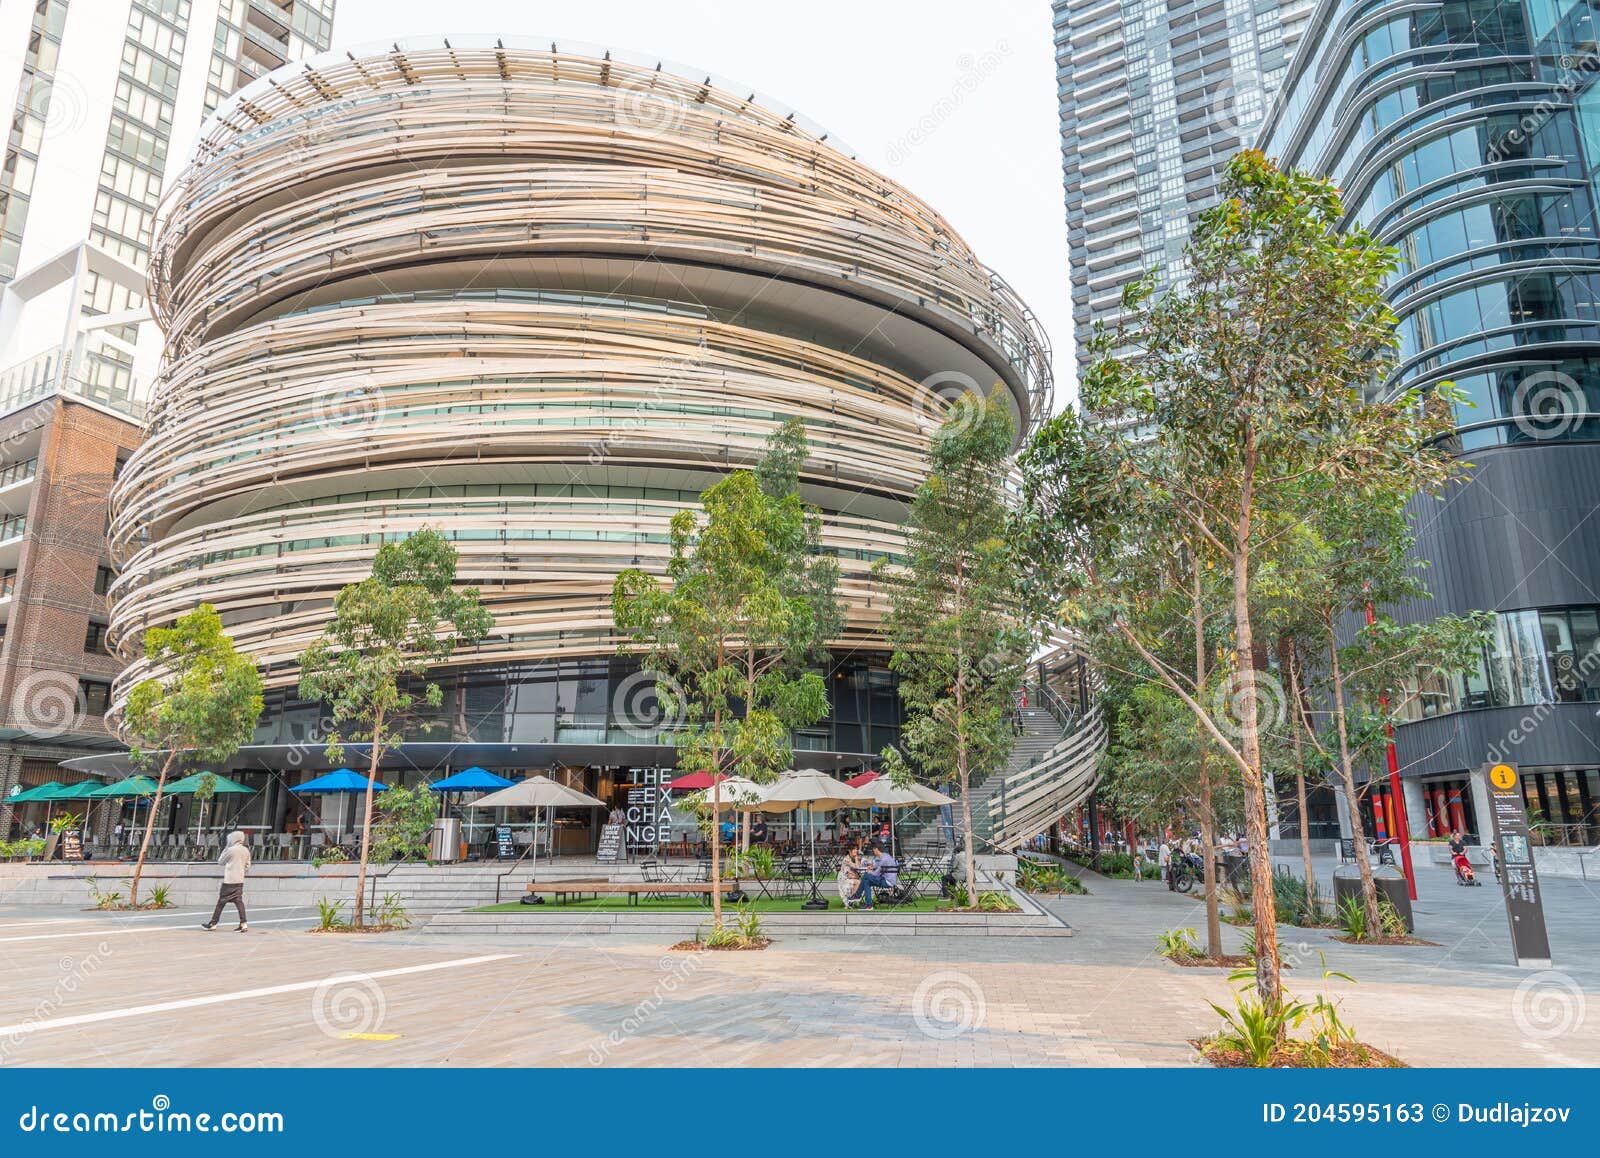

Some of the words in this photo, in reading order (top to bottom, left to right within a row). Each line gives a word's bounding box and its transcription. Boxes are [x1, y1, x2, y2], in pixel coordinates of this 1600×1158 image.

[629, 769, 672, 784] THE
[644, 787, 672, 803] EX
[627, 807, 672, 822] CHA
[627, 826, 670, 842] NGE
